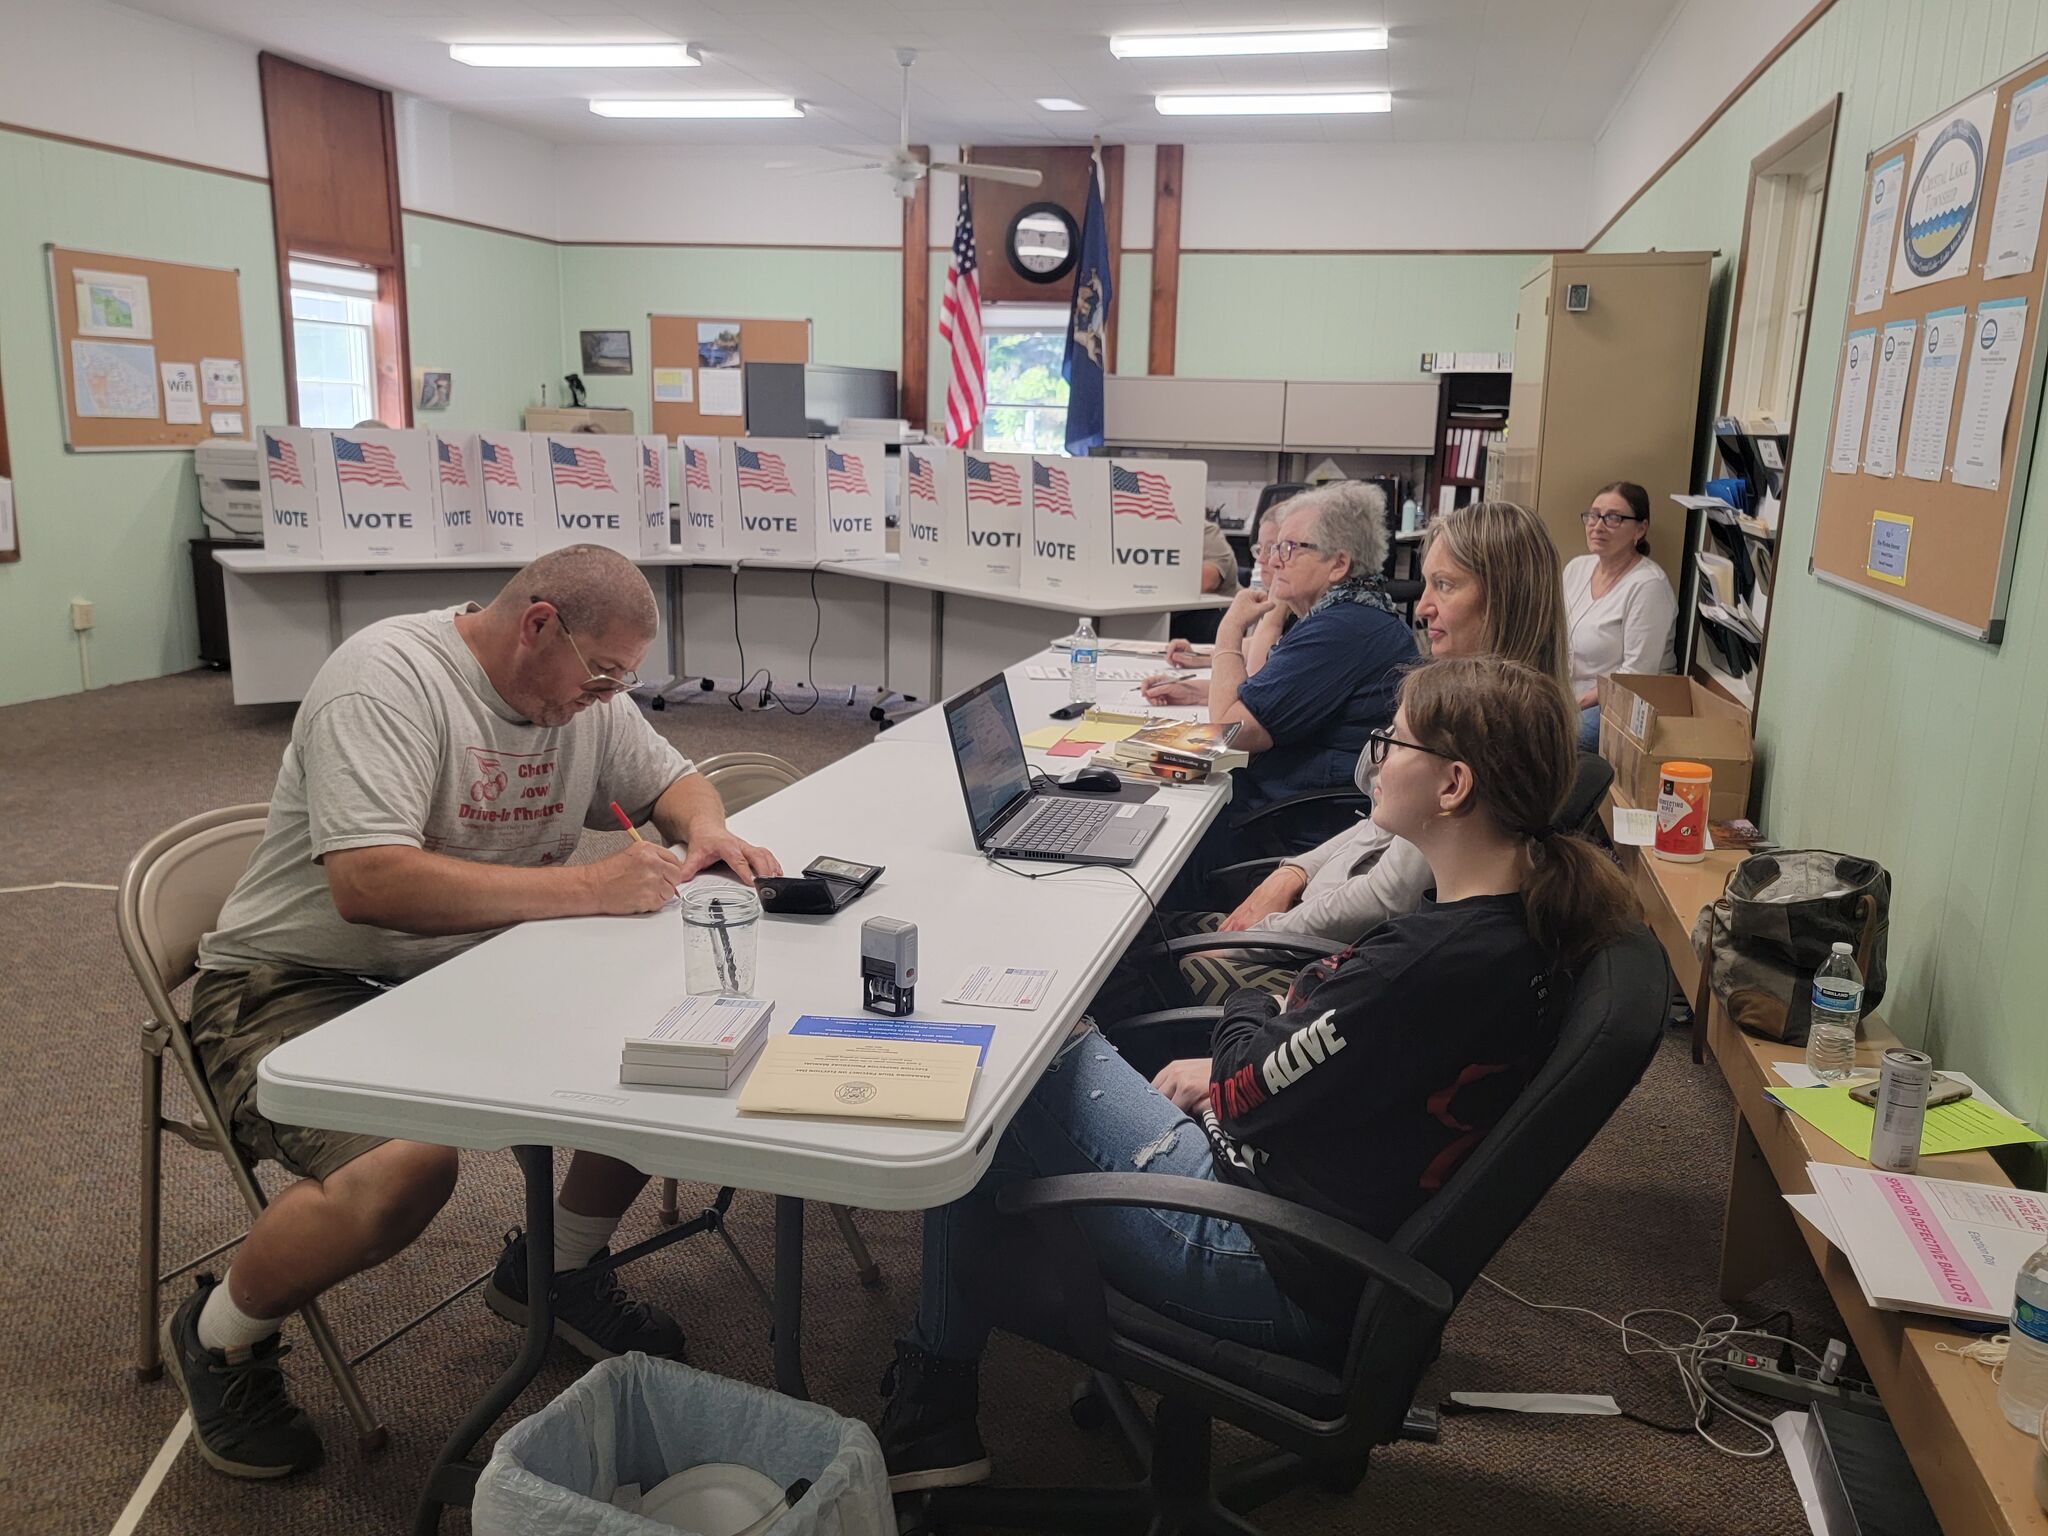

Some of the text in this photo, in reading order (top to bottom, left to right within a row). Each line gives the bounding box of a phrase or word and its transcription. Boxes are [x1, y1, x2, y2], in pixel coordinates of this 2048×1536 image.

[275, 510, 308, 528] VOTE
[347, 513, 413, 528] VOTE
[445, 510, 471, 527] VOTE
[489, 510, 524, 527] VOTE
[561, 514, 620, 529] VOTE
[647, 511, 665, 528] VOTE
[690, 513, 714, 528] VOTE
[745, 516, 797, 532] VOTE
[833, 518, 872, 532] VOTE
[911, 523, 938, 542] VOTE
[1036, 540, 1076, 561] VOTE
[1116, 548, 1181, 566] VOTE
[1263, 1009, 1347, 1095] ALIVE
[2009, 1195, 2045, 1232] ENVELOPE
[1885, 1177, 1973, 1303] SPOILED OR DEFECTIVE BALLOTS
